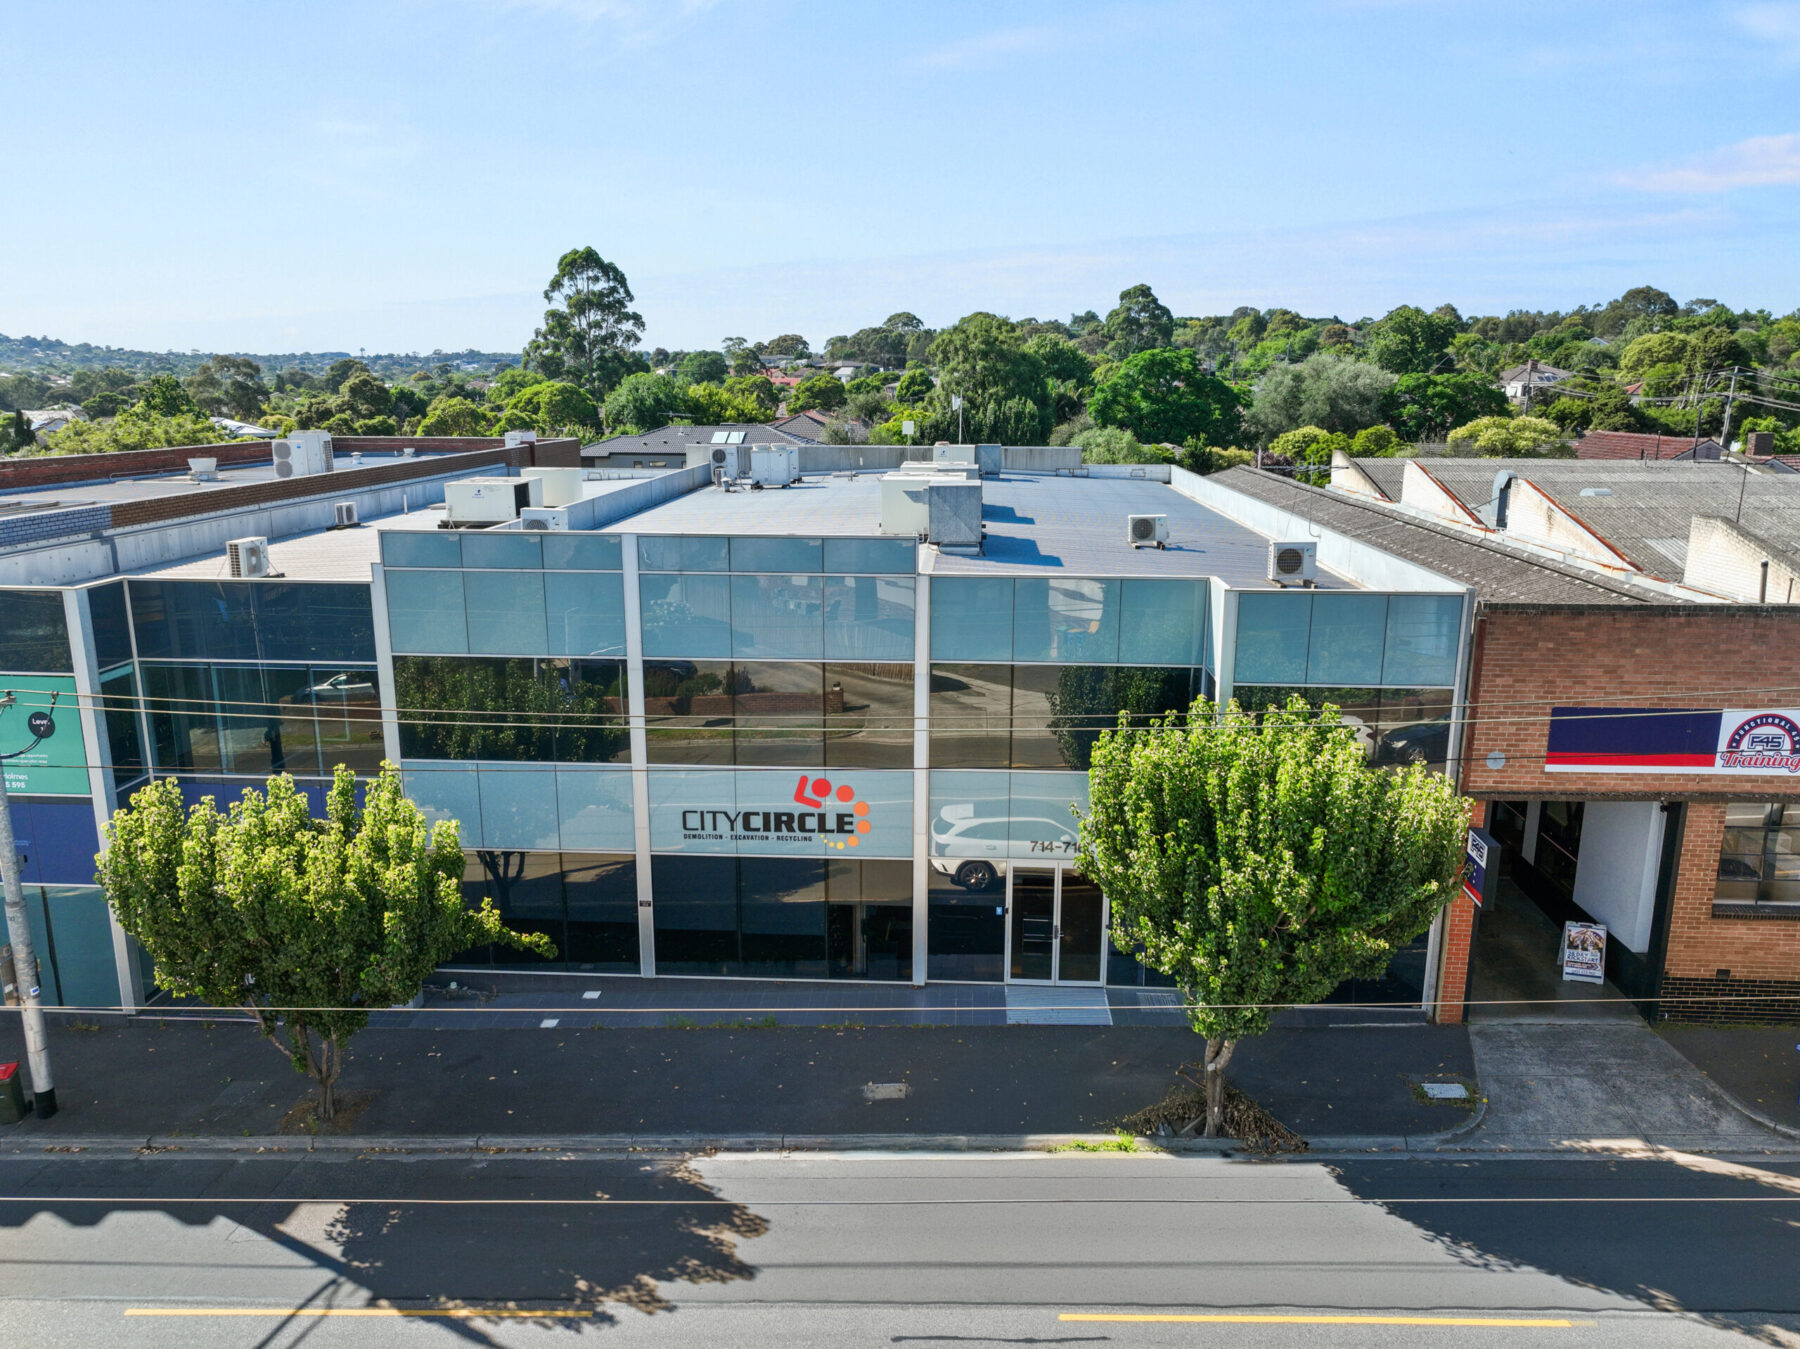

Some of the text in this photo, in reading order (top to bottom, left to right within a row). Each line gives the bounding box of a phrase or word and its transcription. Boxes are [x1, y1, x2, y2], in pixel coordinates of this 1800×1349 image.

[1734, 717, 1791, 740] FUNCTIONAL
[1748, 735, 1784, 749] F45
[1720, 751, 1800, 773] Training
[11, 781, 26, 789] 595
[682, 810, 854, 834] CITYCIRCLE
[1471, 836, 1485, 862] F45
